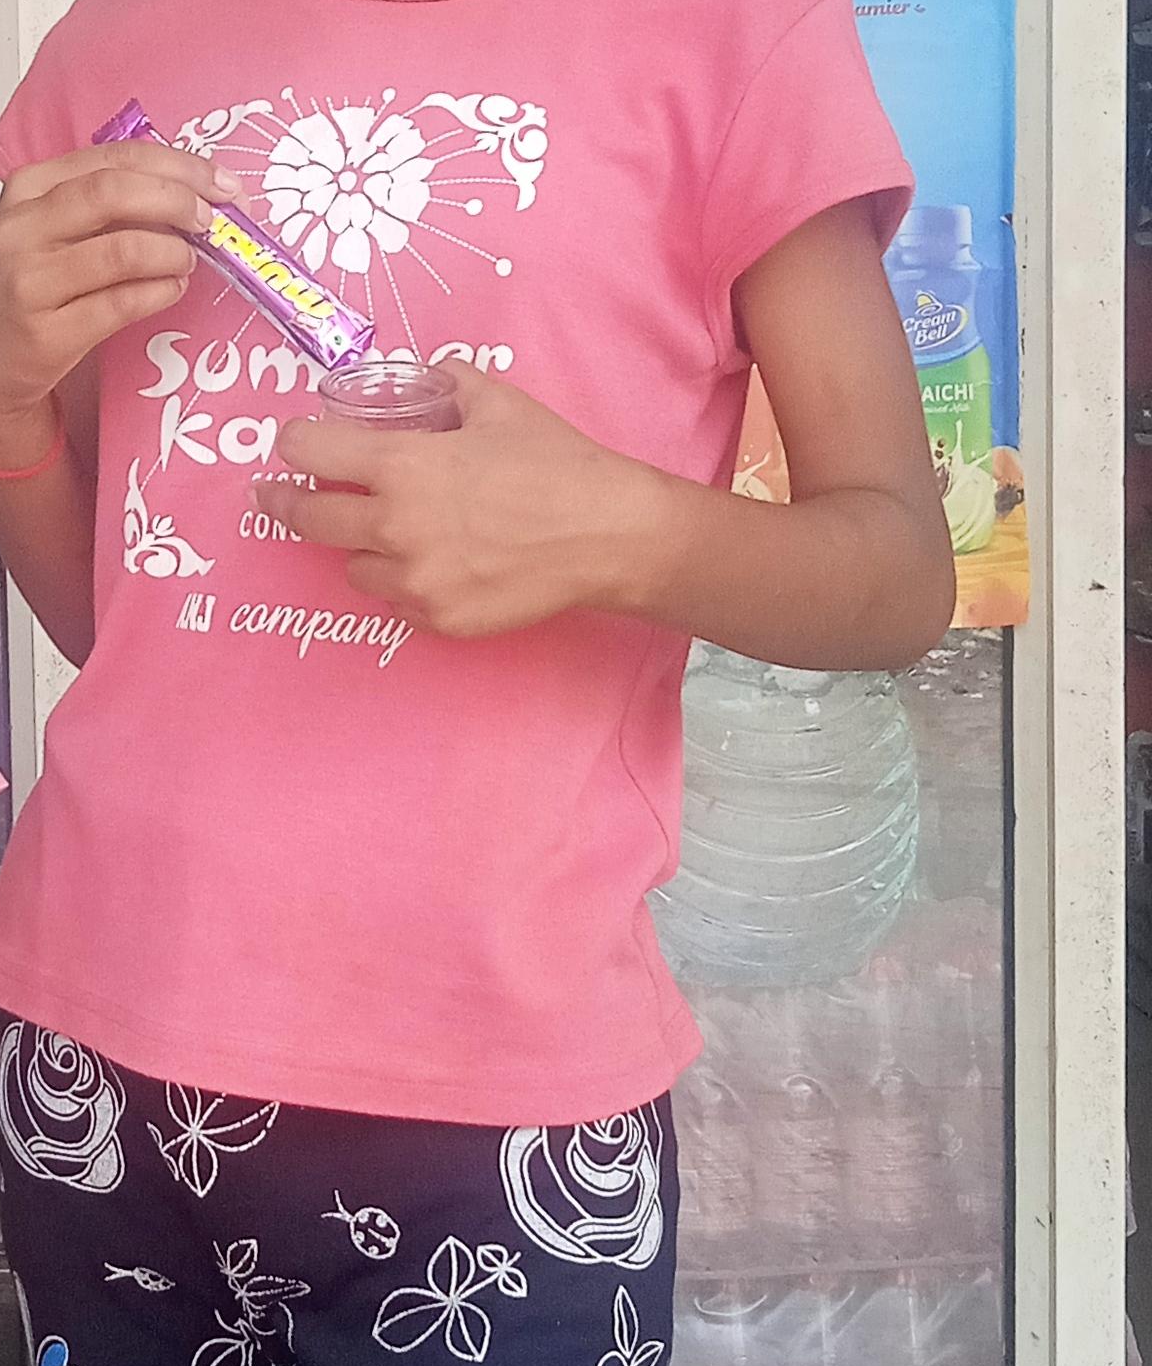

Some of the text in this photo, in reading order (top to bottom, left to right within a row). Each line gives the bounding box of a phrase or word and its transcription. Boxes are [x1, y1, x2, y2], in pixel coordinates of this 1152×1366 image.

[902, 310, 957, 334] Cream
[914, 323, 948, 346] Bell
[920, 382, 975, 403] AICHI
[229, 602, 415, 669] company
